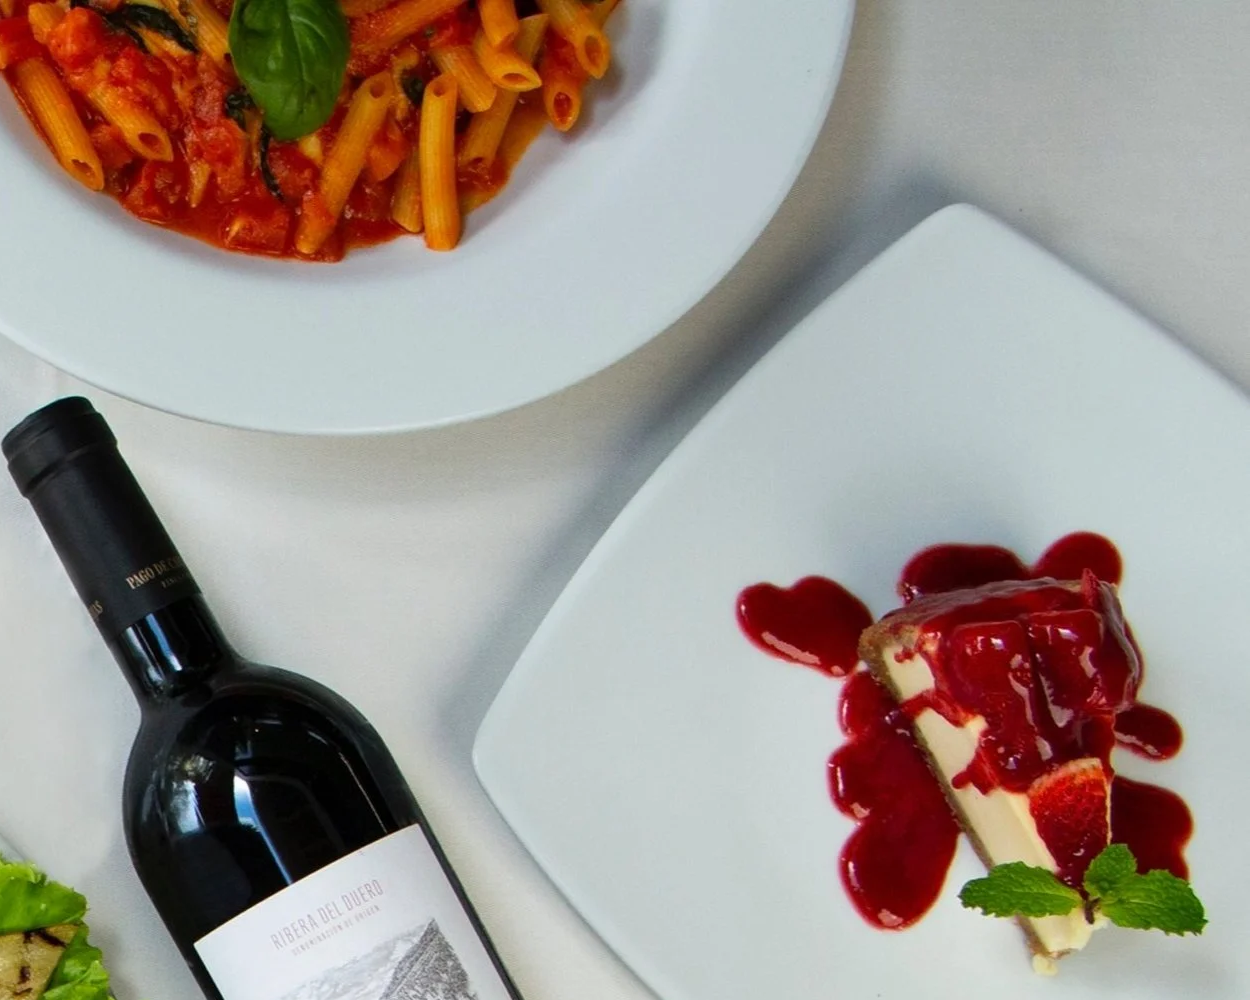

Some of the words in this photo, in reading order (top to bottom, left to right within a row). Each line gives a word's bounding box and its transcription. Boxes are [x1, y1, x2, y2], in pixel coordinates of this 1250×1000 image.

[126, 567, 155, 589] PAGO
[270, 914, 319, 950] RIBERA
[317, 901, 342, 924] DEL
[341, 879, 384, 911] DUERO
